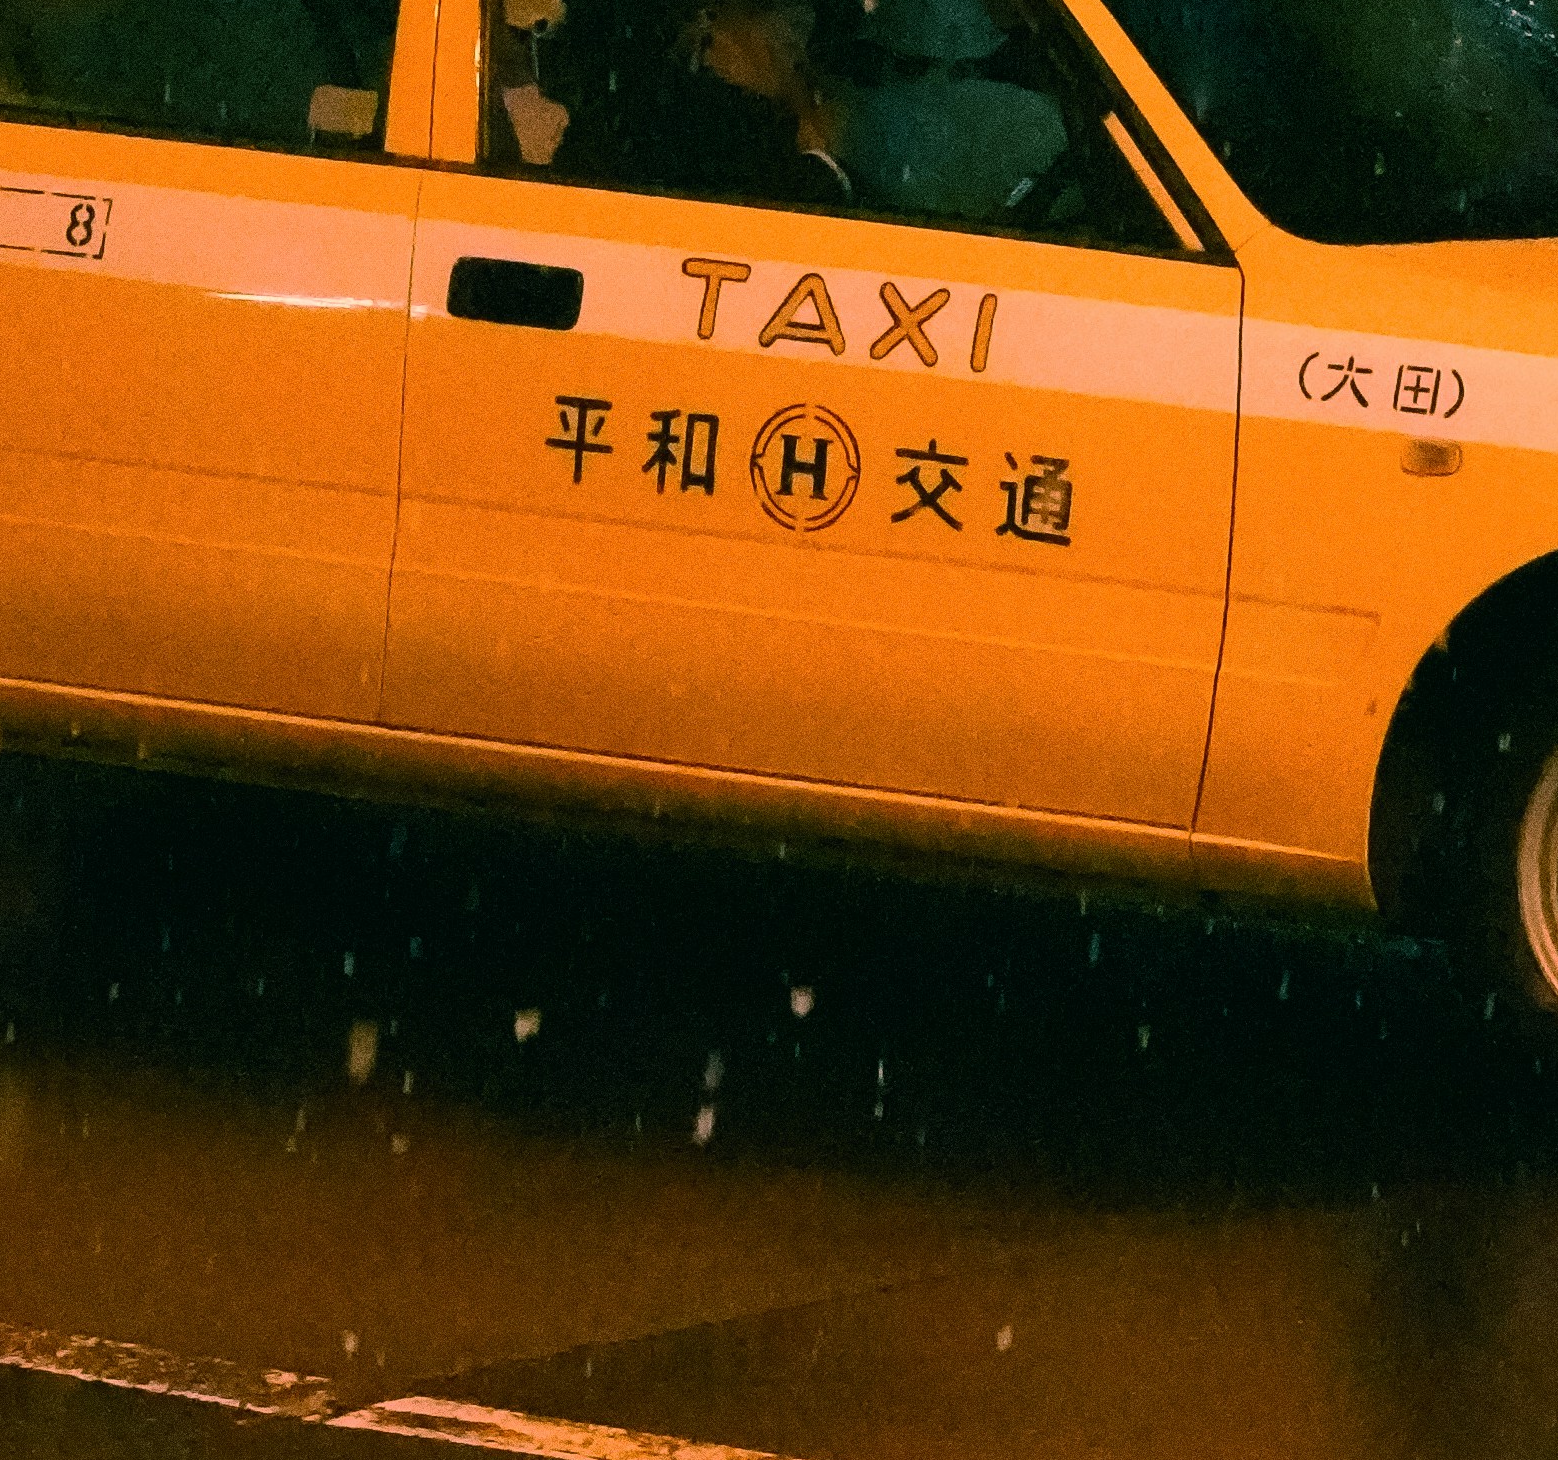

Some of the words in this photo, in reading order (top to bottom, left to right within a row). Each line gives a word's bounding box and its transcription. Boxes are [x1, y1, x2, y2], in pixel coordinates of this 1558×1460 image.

[66, 203, 95, 247] 8
[681, 257, 998, 373] TAXI
[1298, 351, 1465, 419] (大田)
